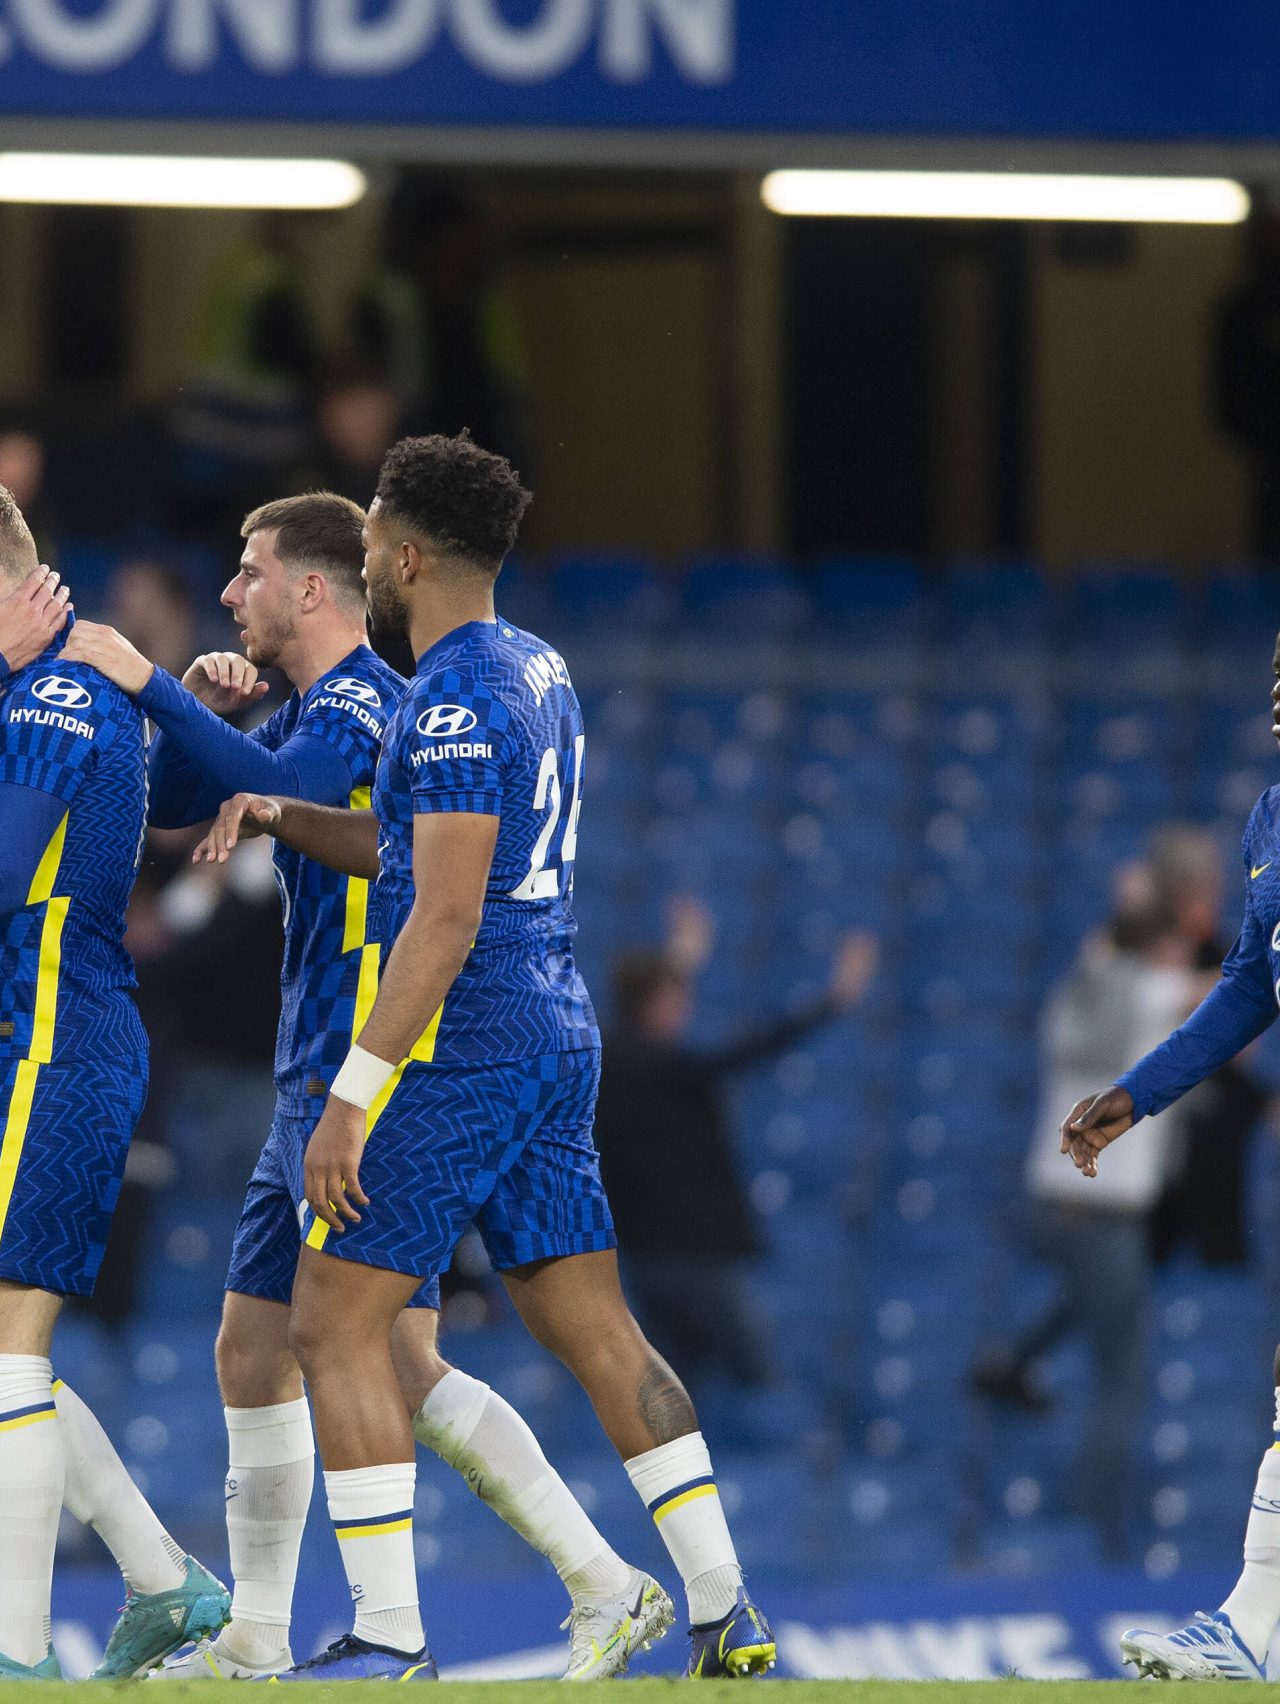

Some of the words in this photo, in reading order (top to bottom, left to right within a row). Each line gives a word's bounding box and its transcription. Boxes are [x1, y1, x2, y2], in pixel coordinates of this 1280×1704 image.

[9, 708, 95, 740] HYUNDAI
[306, 696, 383, 740] HYUNDAI
[410, 743, 493, 767] HYUNDAI
